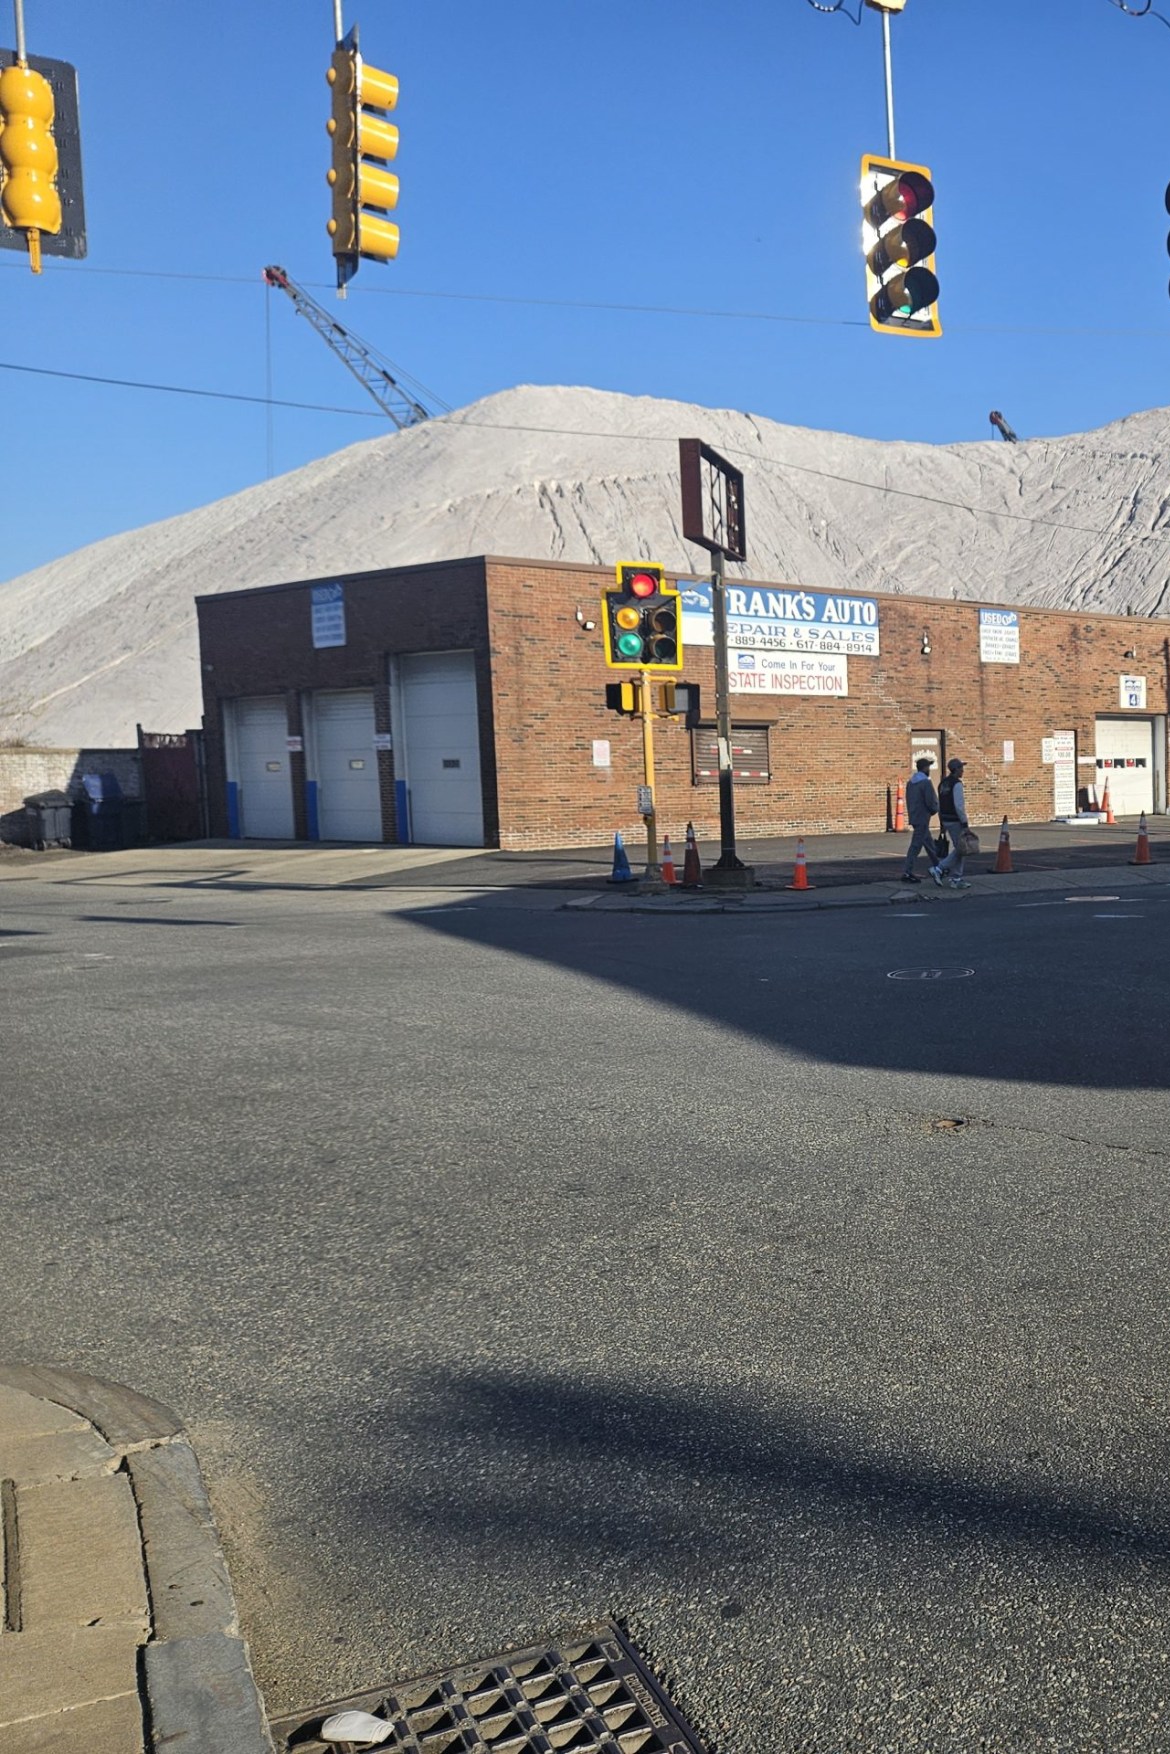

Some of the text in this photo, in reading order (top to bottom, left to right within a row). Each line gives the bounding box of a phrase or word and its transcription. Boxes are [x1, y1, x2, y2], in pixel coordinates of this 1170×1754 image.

[708, 587, 876, 625] RANK'S AUTO
[710, 620, 876, 643] EPAIR & SALES
[761, 659, 786, 670] Come
[789, 660, 798, 670] In
[801, 661, 814, 671] For
[818, 662, 836, 672] Your
[729, 671, 843, 691] STATE INSPECTION
